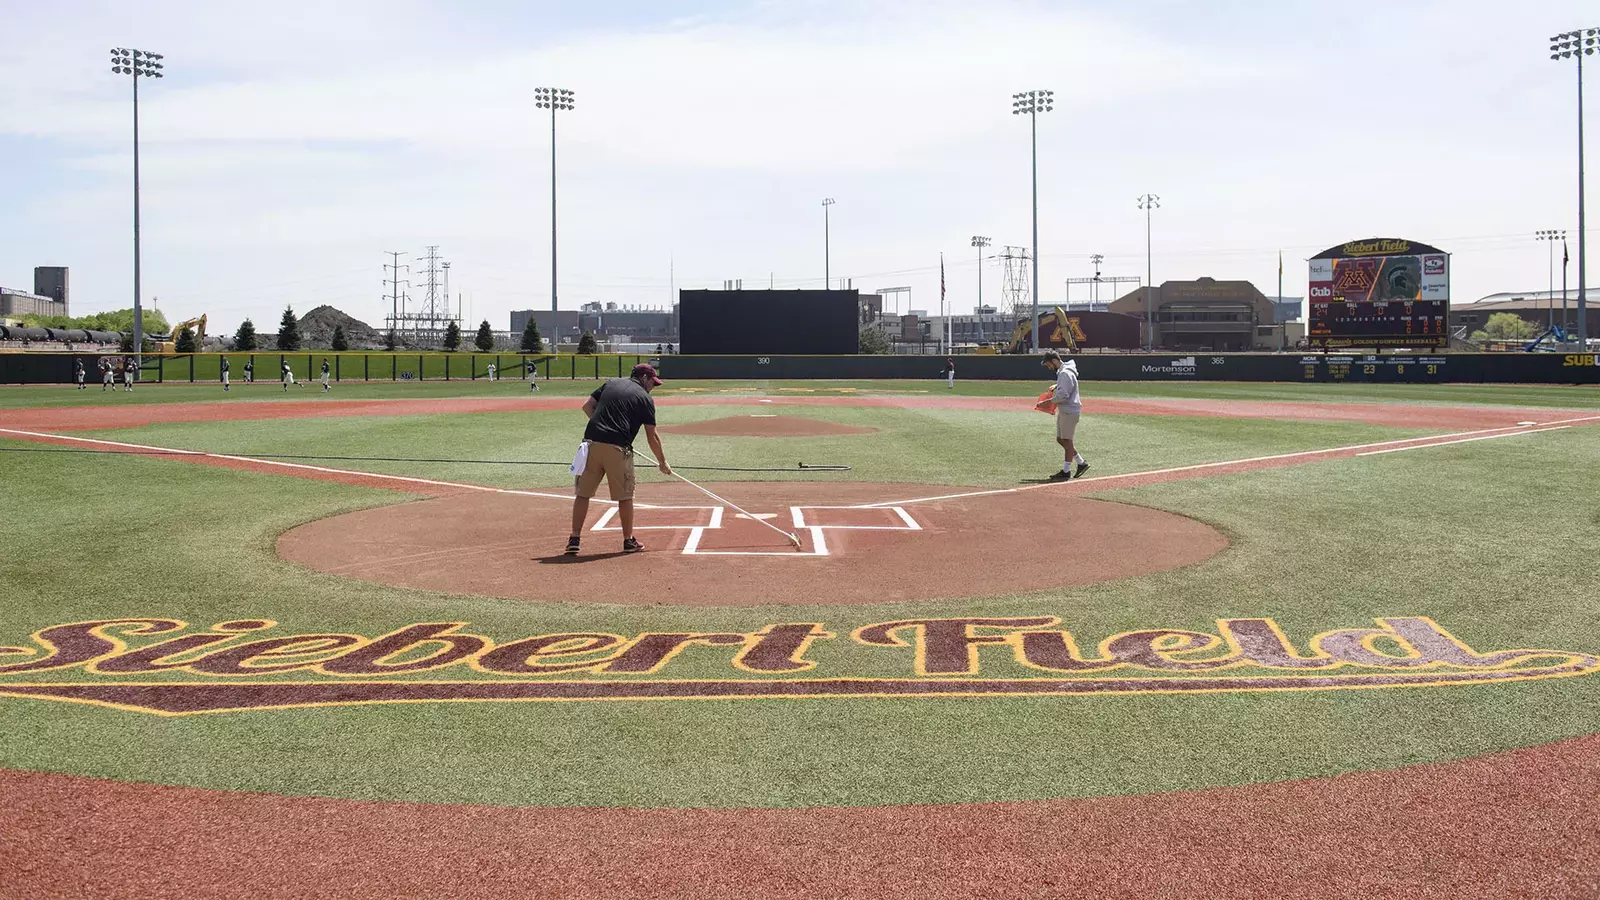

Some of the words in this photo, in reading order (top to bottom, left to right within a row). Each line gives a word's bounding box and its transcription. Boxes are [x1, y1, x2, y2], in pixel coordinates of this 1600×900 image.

[1343, 242, 1379, 253] Siebert
[1381, 240, 1409, 252] Field
[1310, 287, 1331, 297] Cub
[1212, 357, 1225, 365] 365
[1141, 365, 1195, 373] Mortenson
[1363, 365, 1375, 374] 23
[1397, 365, 1404, 374] 8
[1427, 365, 1437, 374] 31
[0, 618, 826, 676] Siebert
[851, 615, 1598, 676] Field
